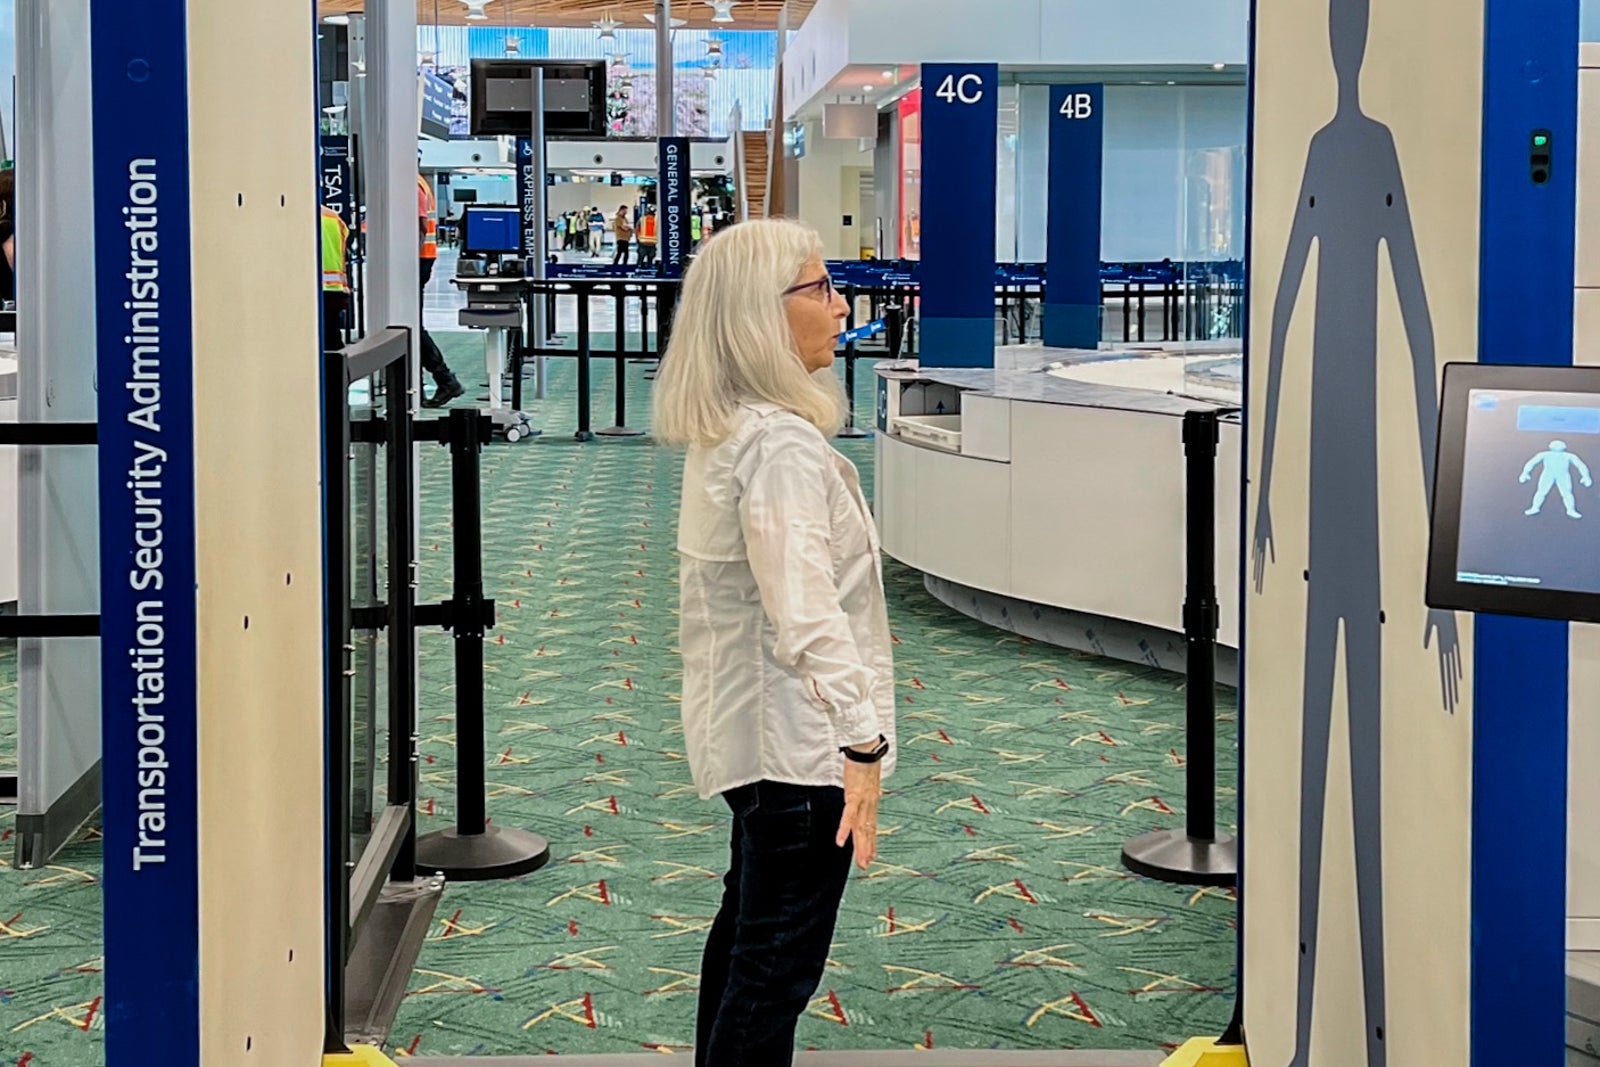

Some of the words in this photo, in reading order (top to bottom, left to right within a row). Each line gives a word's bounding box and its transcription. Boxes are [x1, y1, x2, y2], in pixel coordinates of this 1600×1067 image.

[936, 74, 983, 104] 4C
[1059, 93, 1092, 119] 4B
[324, 164, 342, 198] TSA
[666, 144, 678, 202] GENERAL
[122, 158, 162, 432] Administration
[126, 440, 167, 591] Security
[129, 600, 169, 871] Transportation
